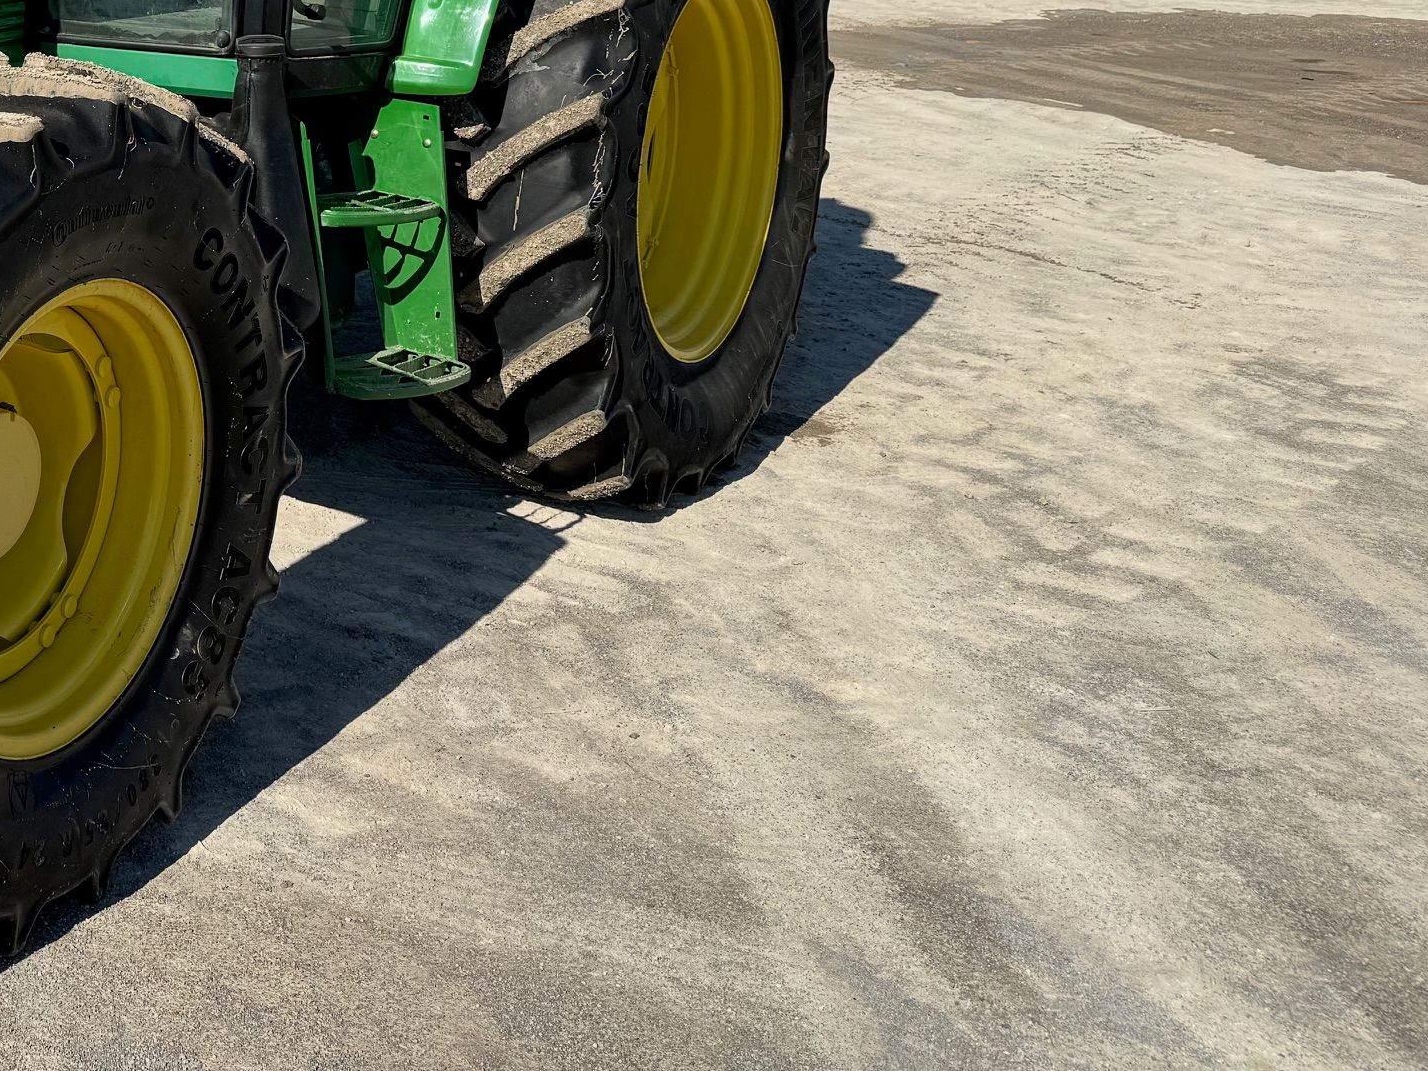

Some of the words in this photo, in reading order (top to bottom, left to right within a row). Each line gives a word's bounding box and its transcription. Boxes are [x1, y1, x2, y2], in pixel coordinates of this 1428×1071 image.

[53, 193, 146, 247] Continental
[192, 226, 270, 515] CONTRACT
[181, 542, 251, 699] AC85
